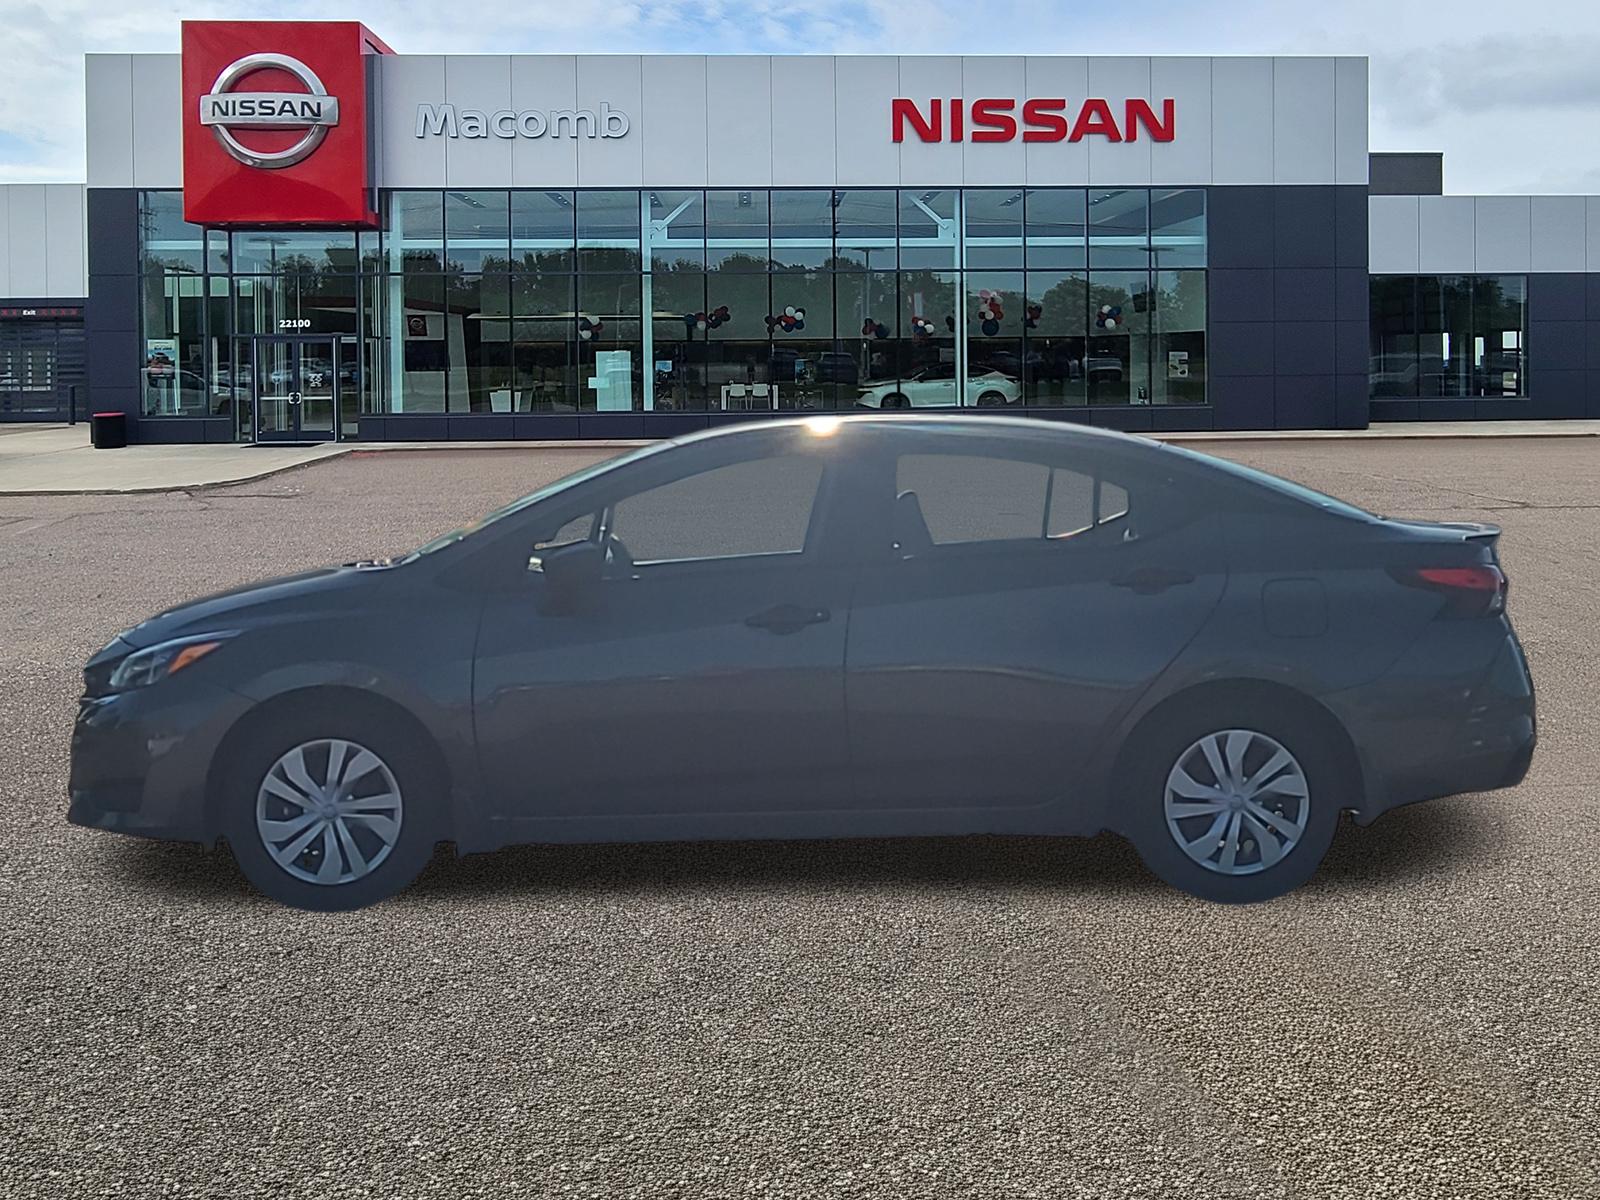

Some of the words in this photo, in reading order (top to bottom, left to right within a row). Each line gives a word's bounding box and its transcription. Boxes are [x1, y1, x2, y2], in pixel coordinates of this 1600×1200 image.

[212, 100, 321, 117] NISSAN
[415, 102, 630, 138] Macomb
[892, 98, 1175, 143] NISSAN
[279, 319, 311, 328] 22100
